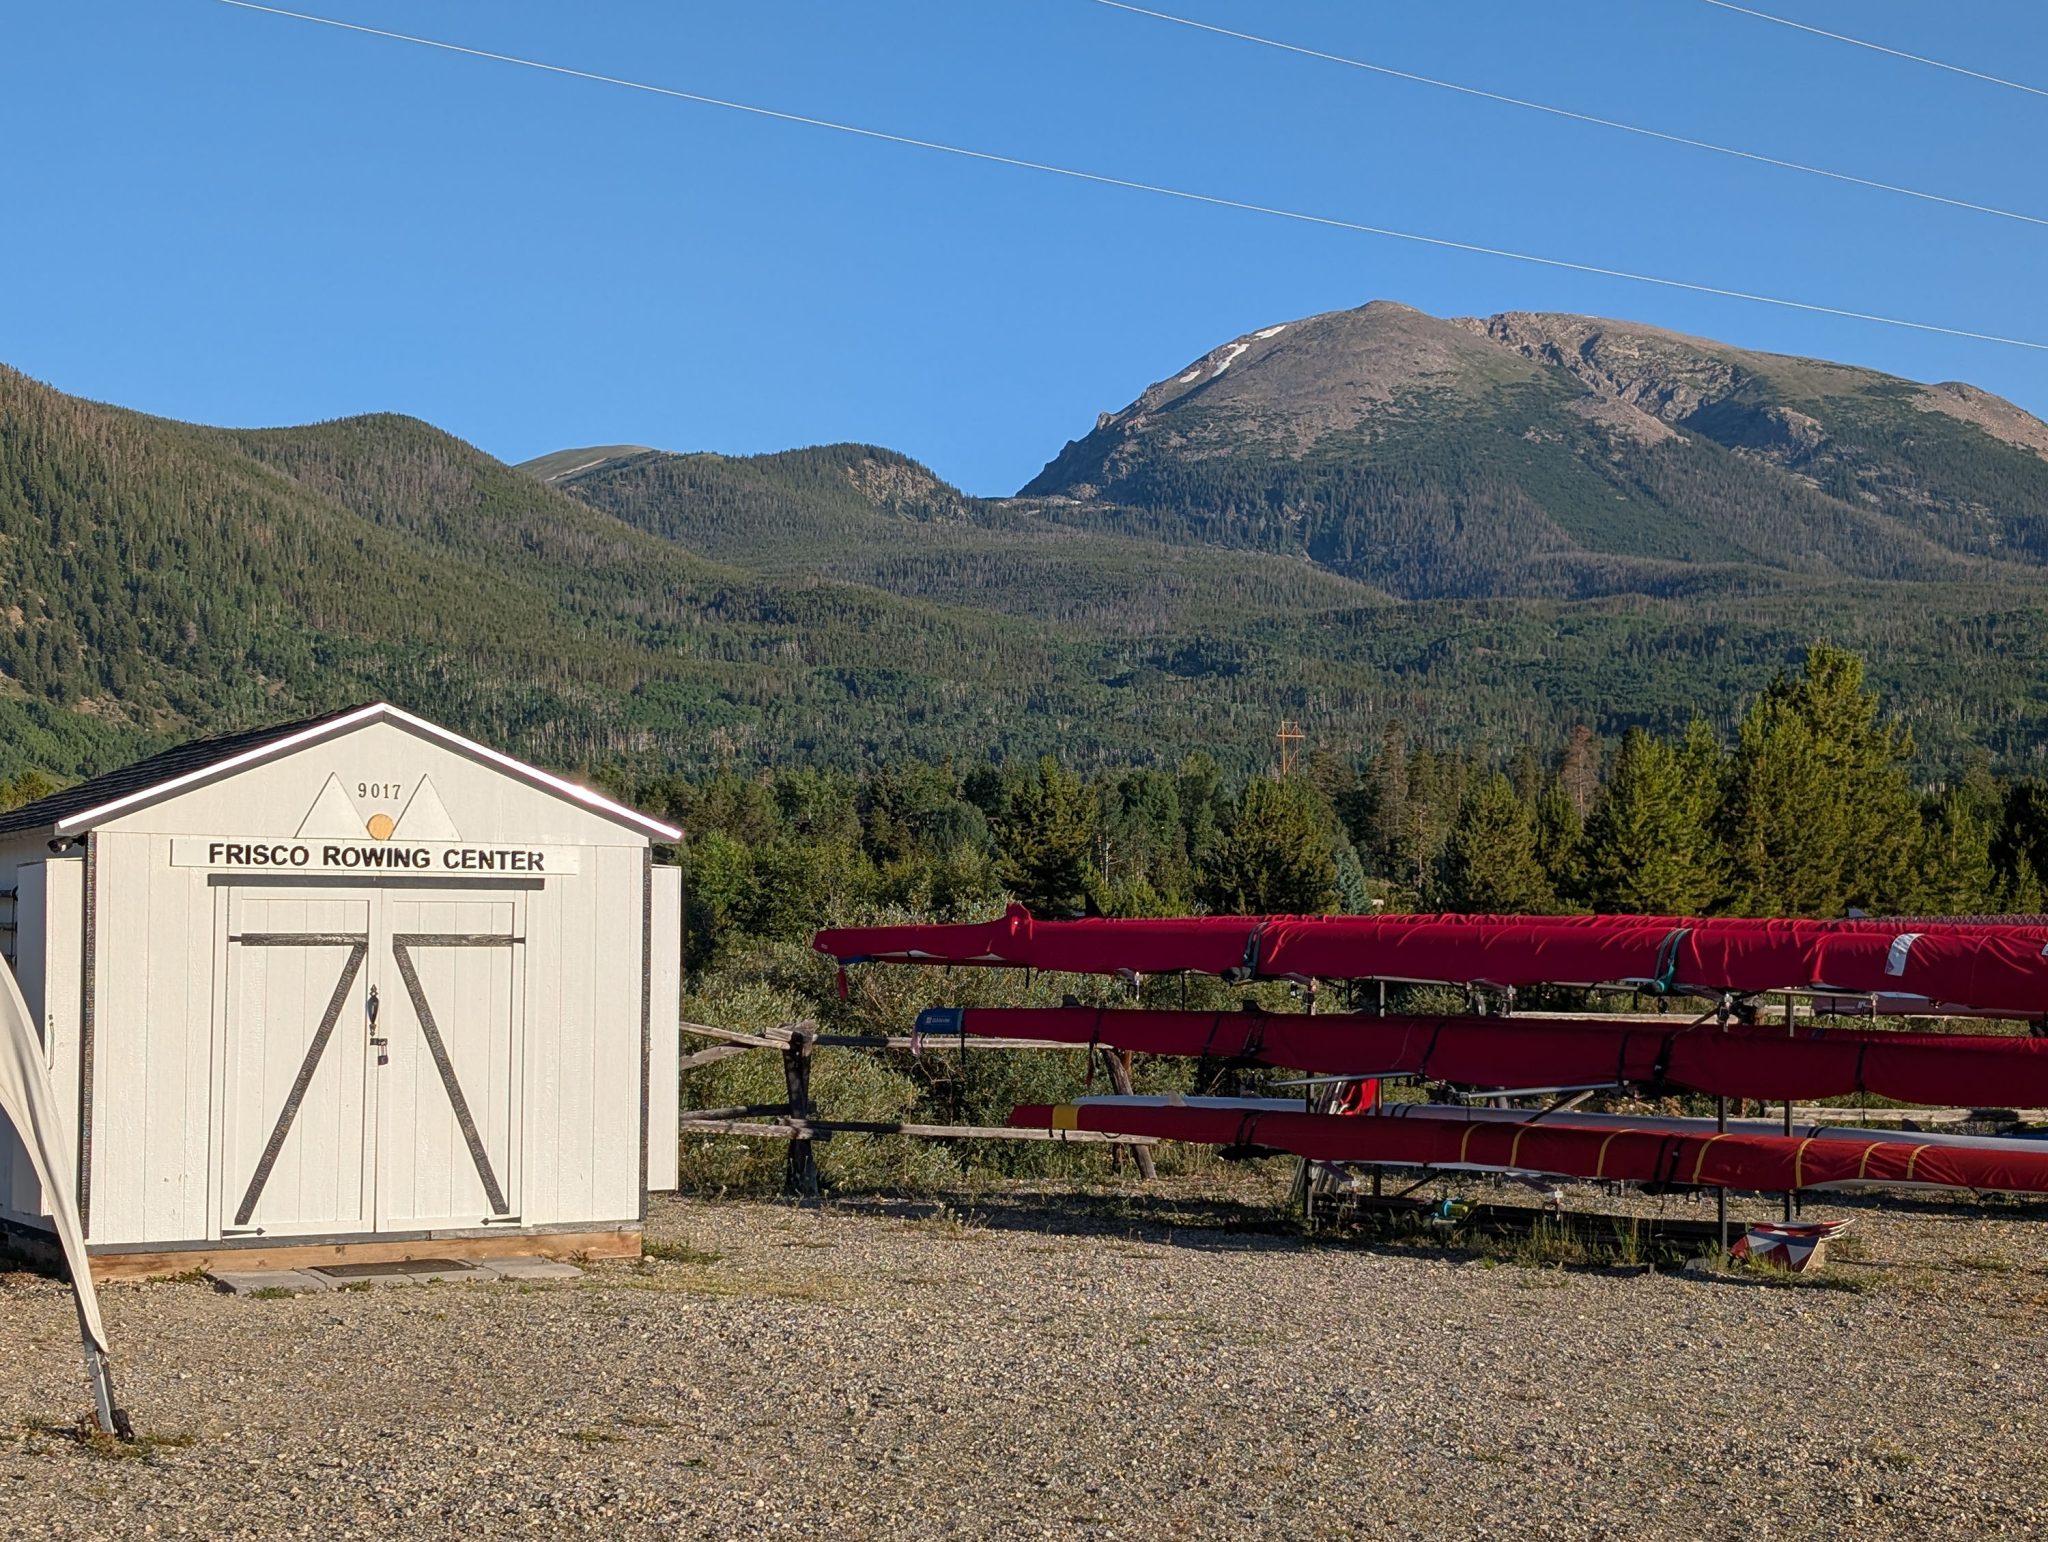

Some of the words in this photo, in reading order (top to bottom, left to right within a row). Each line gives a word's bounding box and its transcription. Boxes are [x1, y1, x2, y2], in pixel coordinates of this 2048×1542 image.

[358, 782, 401, 800] 9017
[209, 843, 309, 866] FRISCO
[323, 845, 430, 868] ROWING
[443, 849, 545, 871] CENTER
